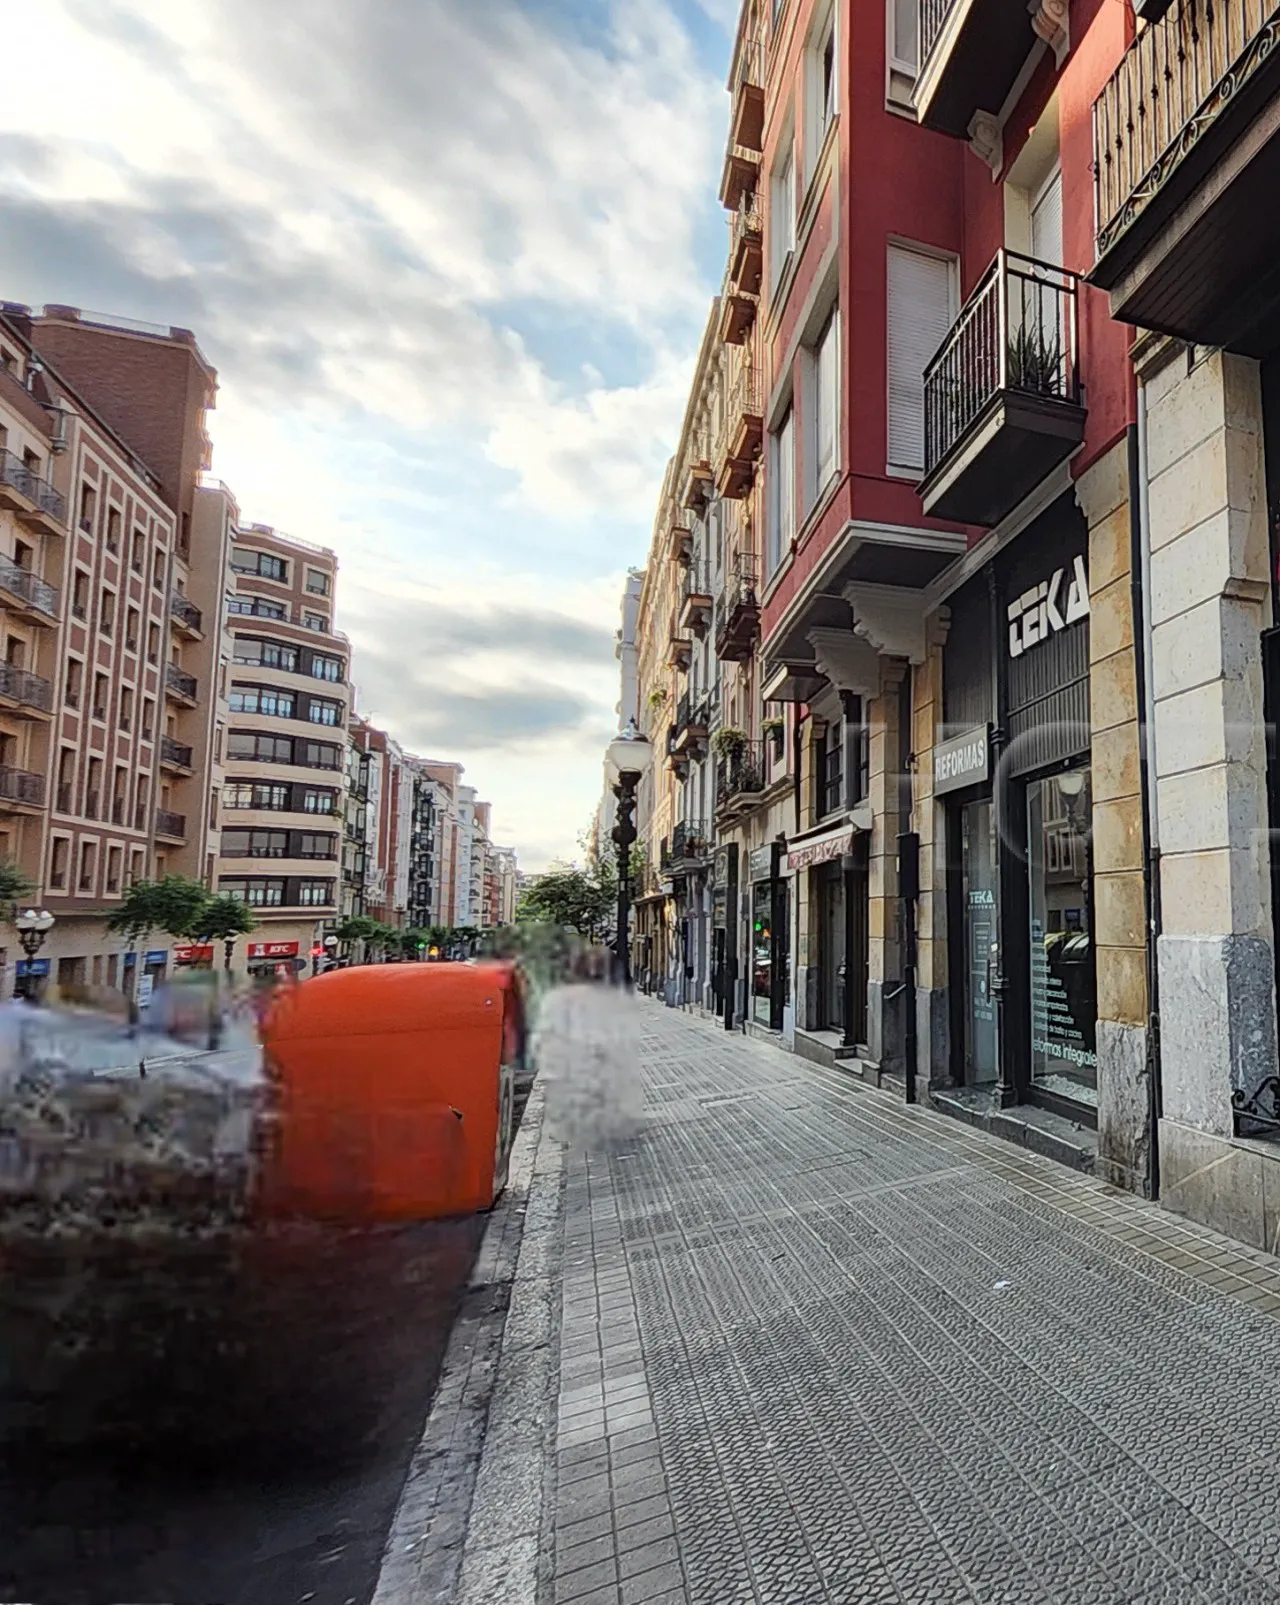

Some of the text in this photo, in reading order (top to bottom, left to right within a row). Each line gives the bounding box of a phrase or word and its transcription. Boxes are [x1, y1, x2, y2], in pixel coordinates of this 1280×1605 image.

[1008, 555, 1090, 657] TEKA
[935, 738, 985, 783] REFORMAS
[969, 890, 994, 904] TEKA
[269, 944, 290, 953] KFC
[1032, 1036, 1098, 1068] eformas integrale
